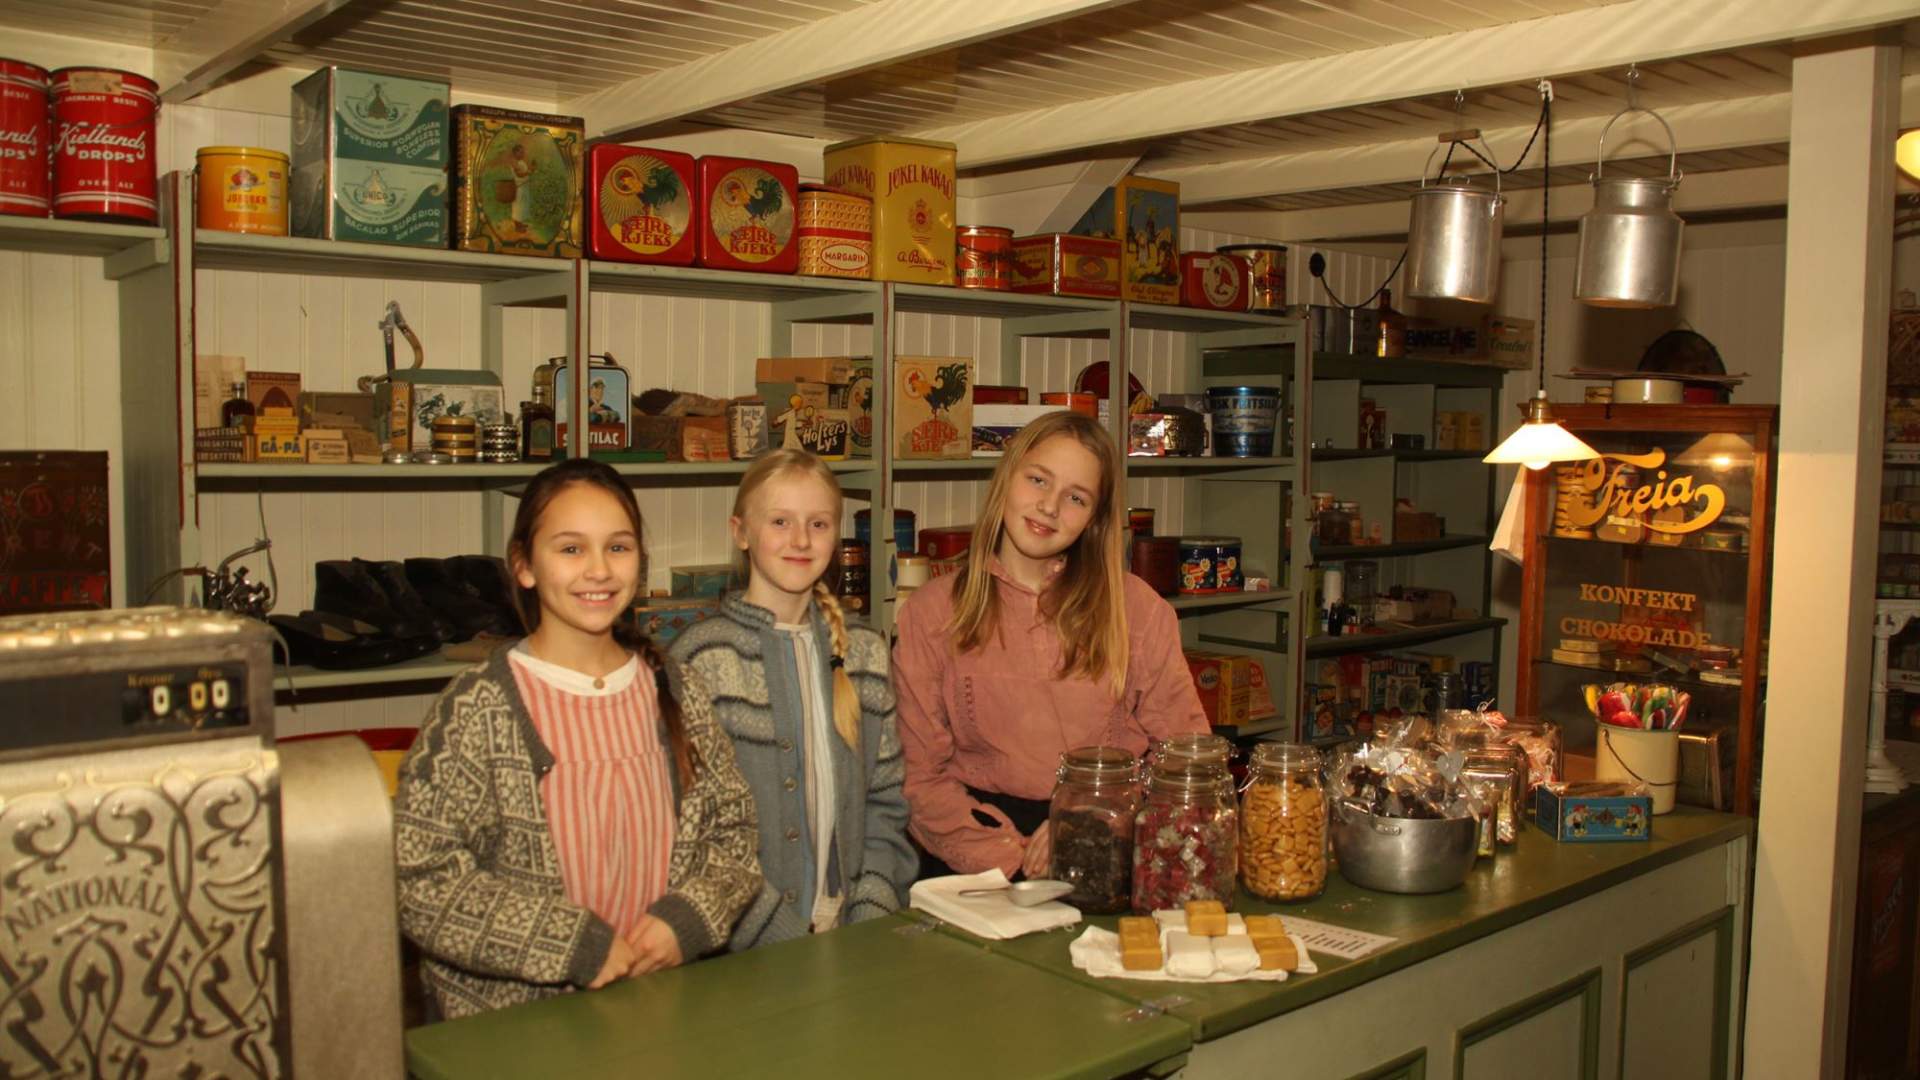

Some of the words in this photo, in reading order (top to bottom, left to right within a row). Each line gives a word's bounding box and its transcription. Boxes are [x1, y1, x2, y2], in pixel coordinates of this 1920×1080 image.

[78, 149, 135, 163] DROPS
[920, 163, 954, 201] KAKAO
[621, 231, 672, 247] KJEKS
[730, 240, 777, 256] KJEKS
[823, 251, 866, 263] MARGARIN
[1567, 447, 1726, 535] Freia
[1580, 584, 1697, 612] KONFEKT
[1559, 617, 1713, 650] CHOKOLADE
[4, 874, 170, 943] NATIONAL
